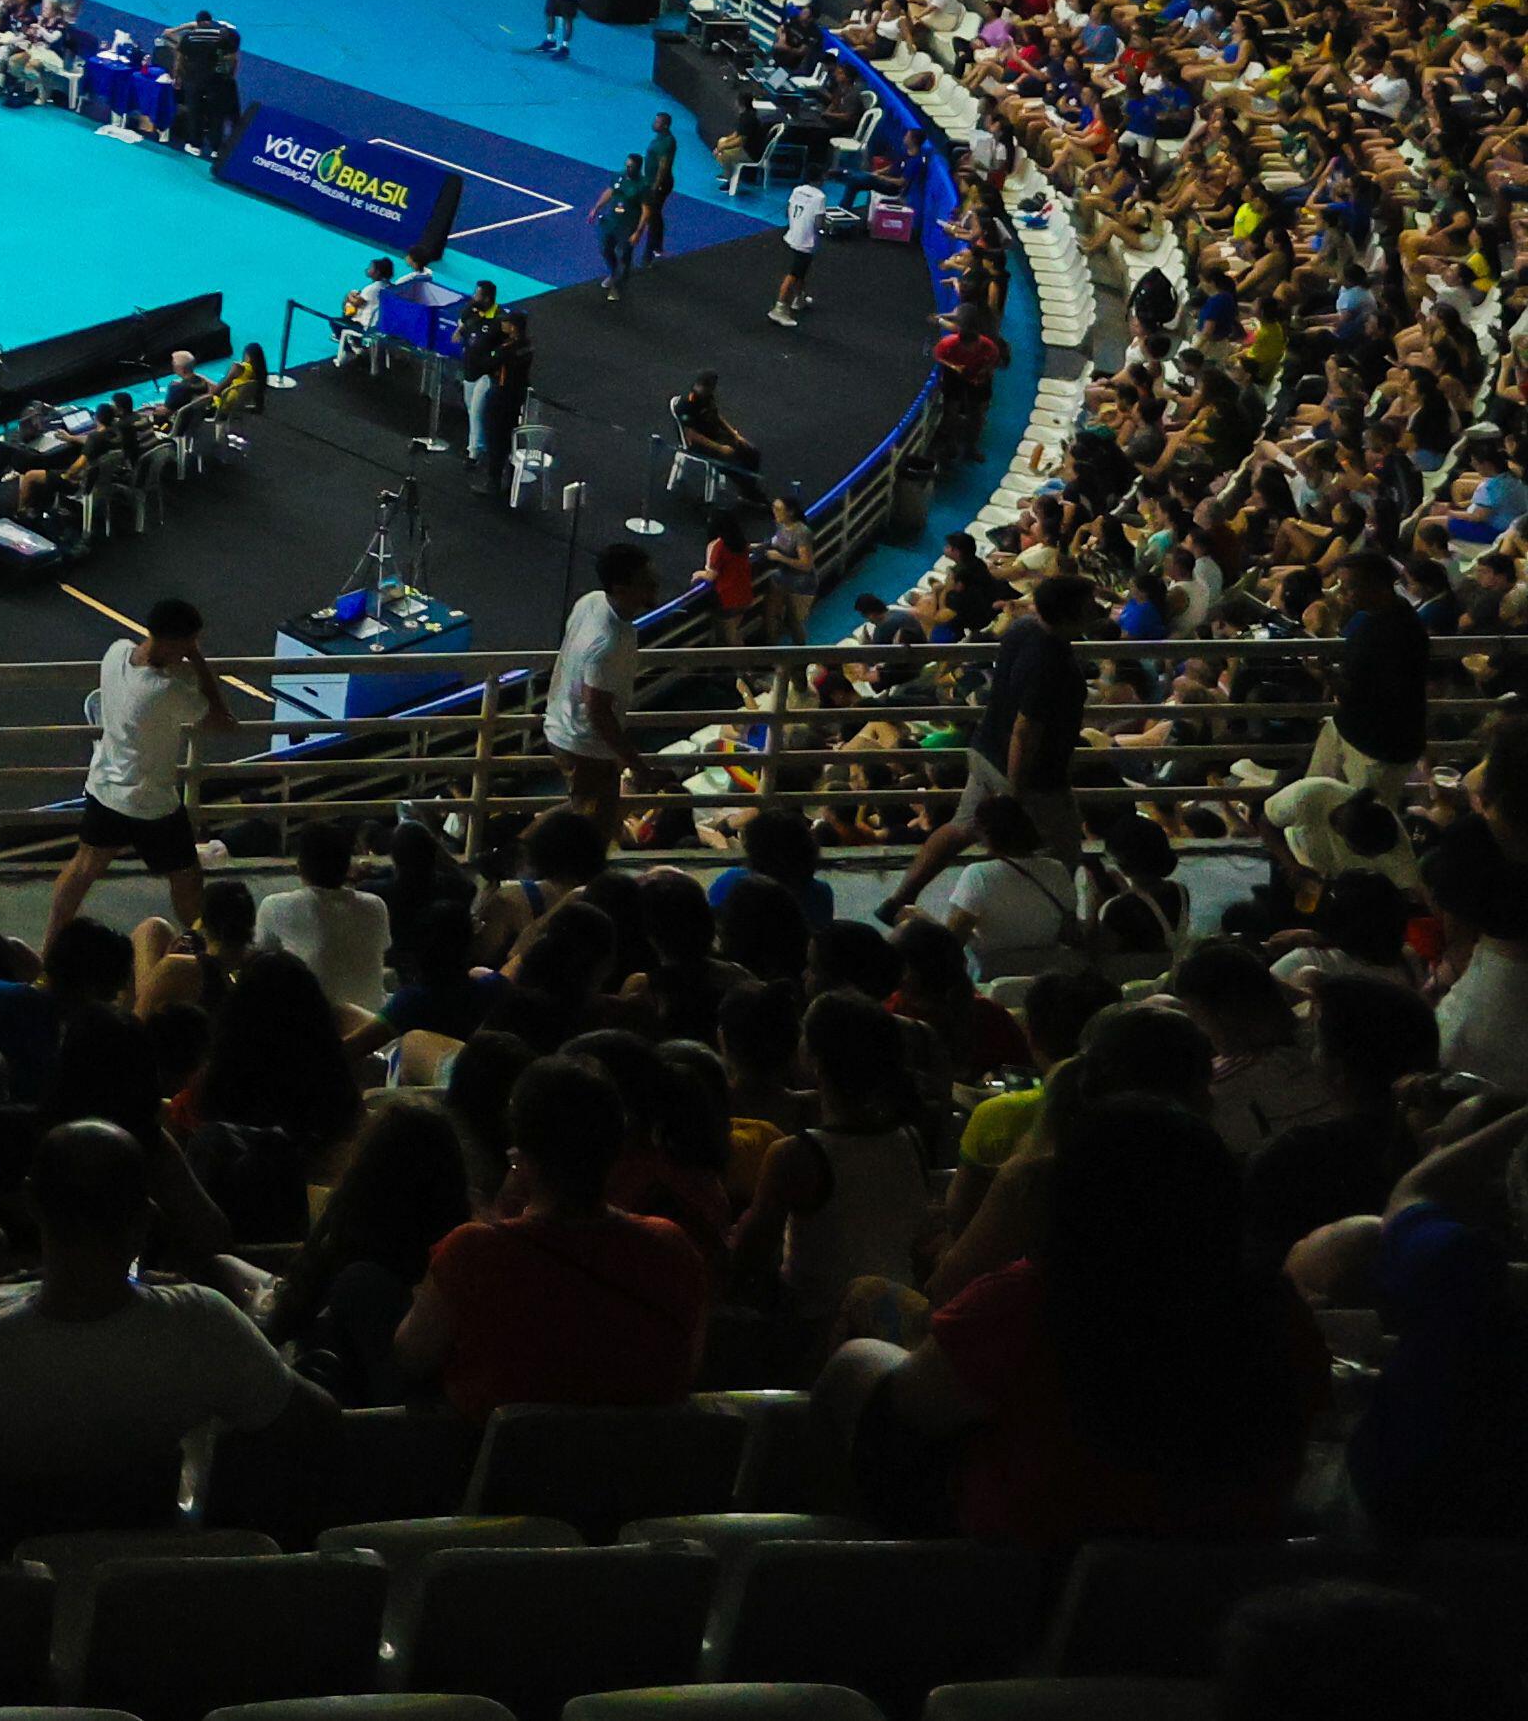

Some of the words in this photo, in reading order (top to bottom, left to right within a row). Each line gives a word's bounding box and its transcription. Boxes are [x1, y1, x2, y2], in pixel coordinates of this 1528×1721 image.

[264, 133, 321, 171] VÔLEI
[336, 165, 408, 209] BRASIL
[351, 197, 365, 209] DE
